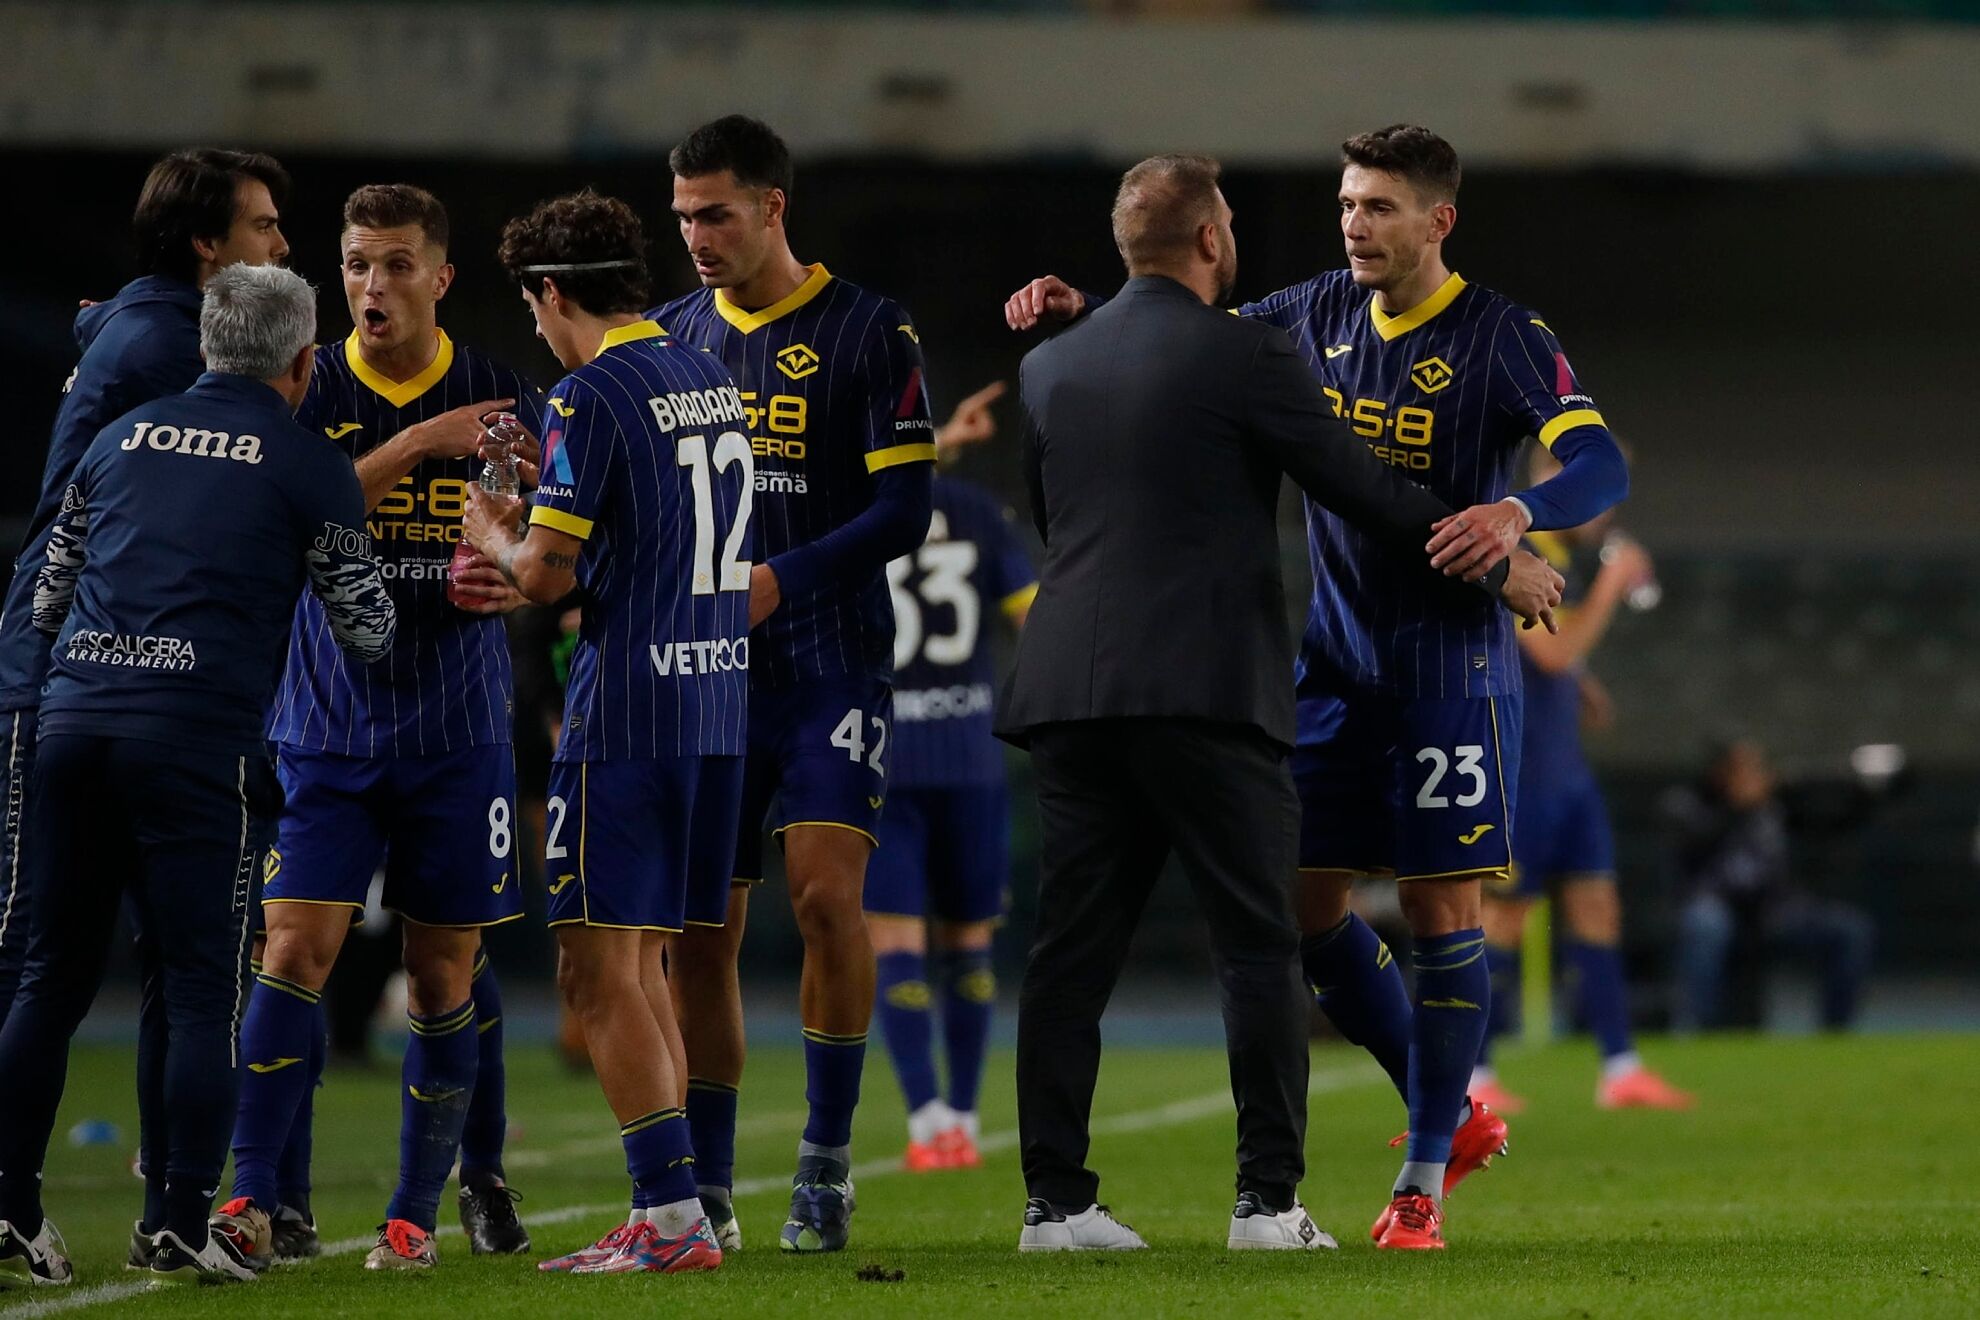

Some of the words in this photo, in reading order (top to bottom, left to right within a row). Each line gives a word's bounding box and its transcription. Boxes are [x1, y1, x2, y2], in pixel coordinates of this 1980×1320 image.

[121, 422, 263, 464] Joma
[1367, 443, 1431, 469] ERO
[678, 431, 754, 594] 12
[66, 648, 195, 670] ARREDAMENTI
[88, 631, 195, 660] SCALIGERA
[830, 708, 885, 778] 42
[1415, 745, 1486, 808] 23
[488, 796, 511, 859] 8
[546, 795, 568, 859] 2
